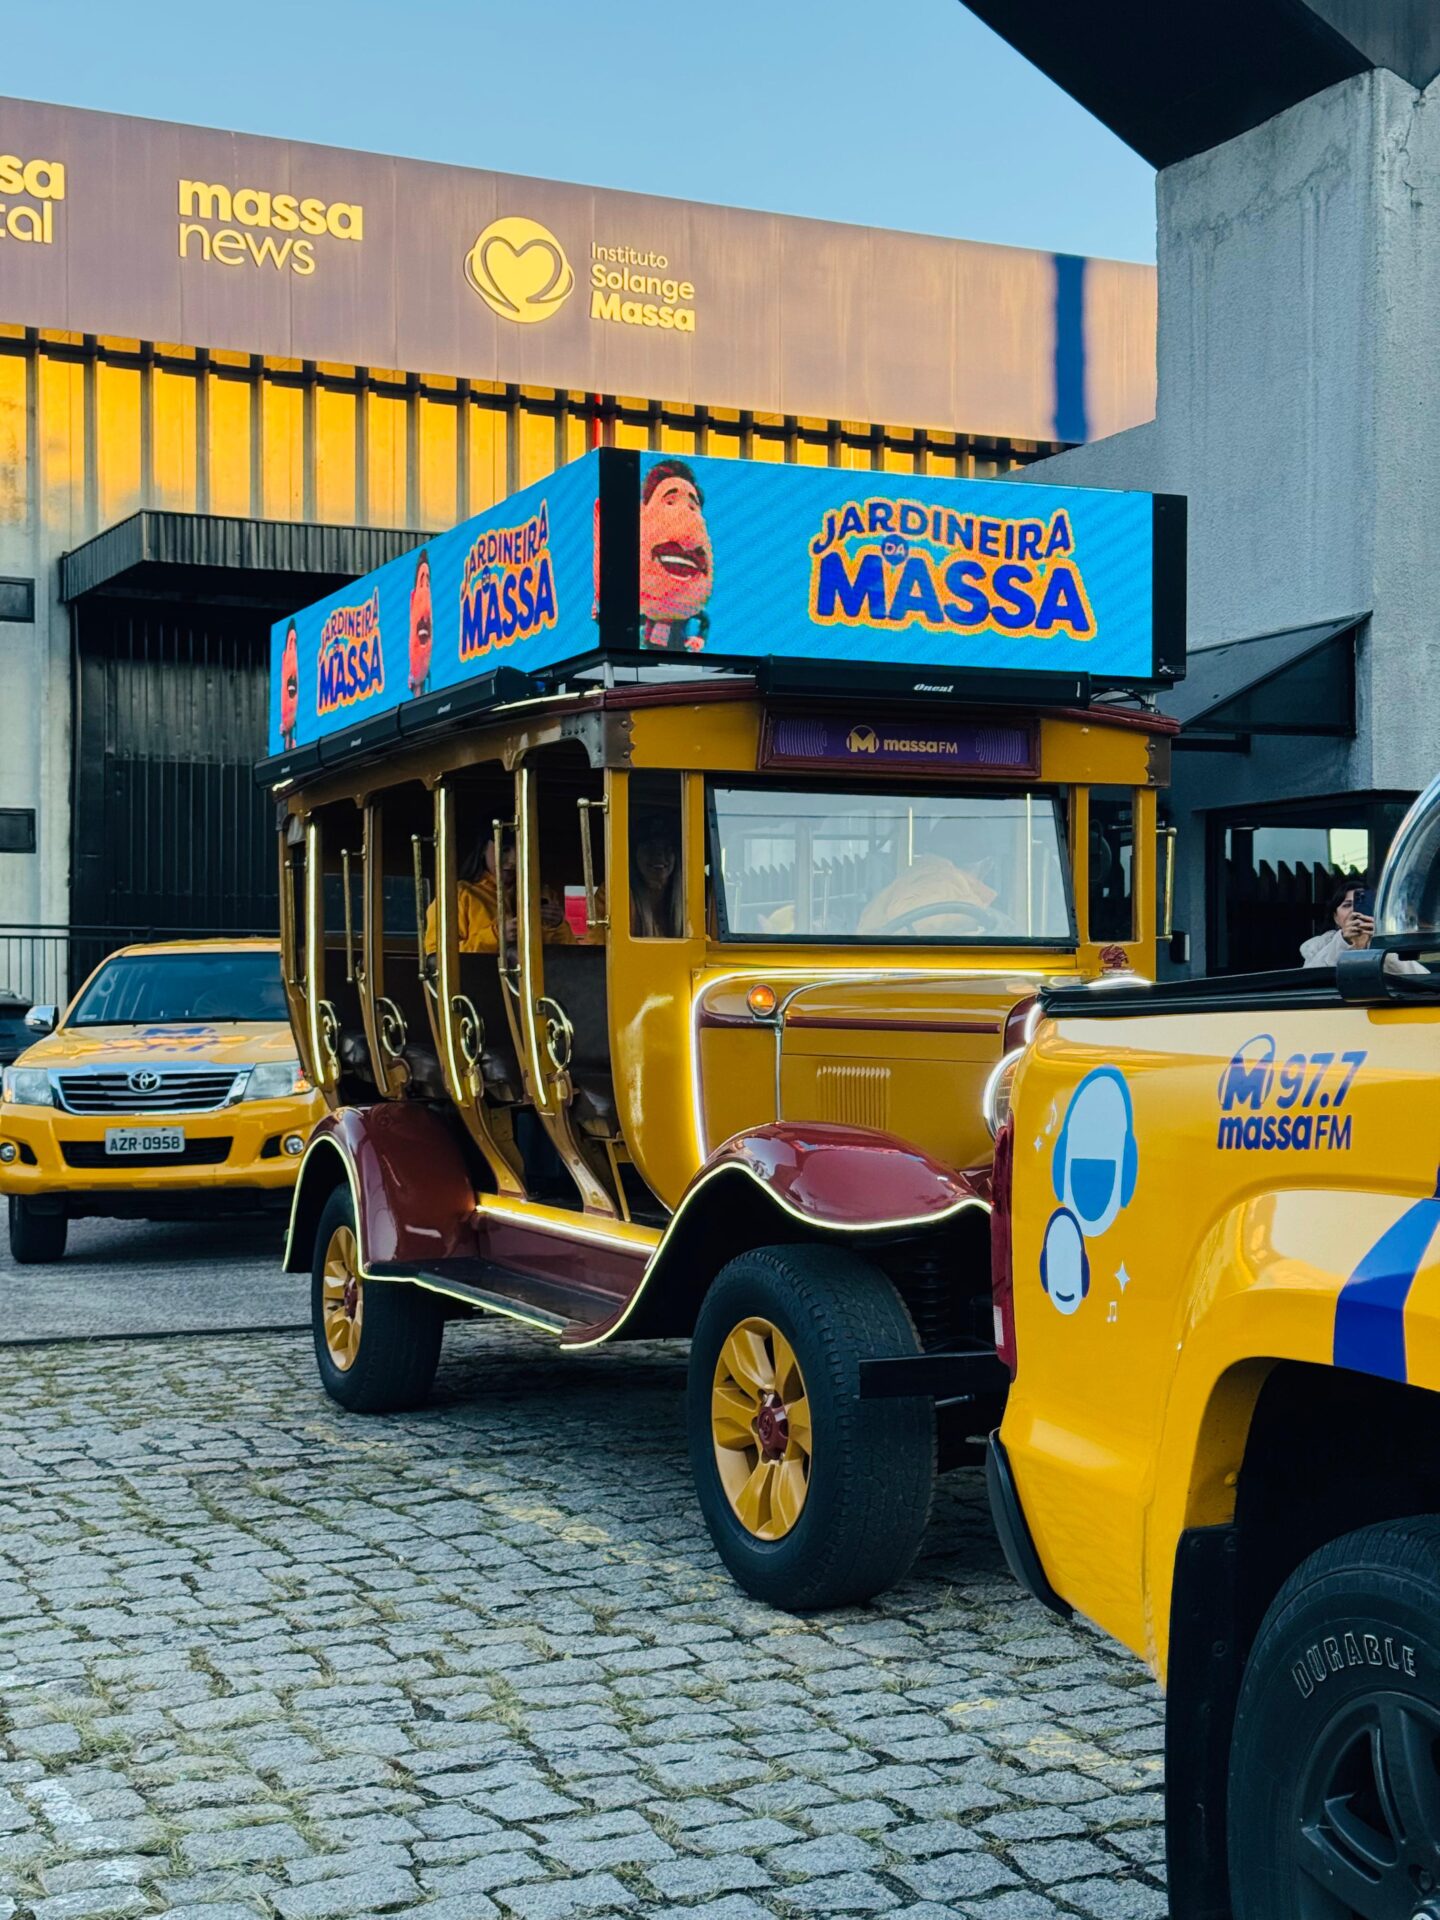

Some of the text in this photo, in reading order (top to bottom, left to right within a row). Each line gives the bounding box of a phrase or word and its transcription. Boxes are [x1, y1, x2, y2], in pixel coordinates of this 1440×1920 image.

[0, 200, 53, 244] al
[179, 179, 363, 240] massa
[179, 222, 316, 275] news
[591, 241, 668, 269] Instituto
[591, 264, 695, 304] Solange
[591, 290, 696, 332] Massa
[460, 503, 548, 600] JARDINEIRA
[813, 501, 1071, 560] JARDINEIRA
[884, 542, 906, 555] DA
[461, 557, 555, 656] MASSA
[816, 551, 1091, 632] MASSA
[319, 634, 383, 710] MASSA
[883, 739, 959, 755] massaFM
[1276, 1050, 1368, 1109] 97.7
[109, 1136, 180, 1151] AZR-0958
[1216, 1114, 1353, 1151] massaFM
[1291, 1631, 1417, 1700] DURABLE
